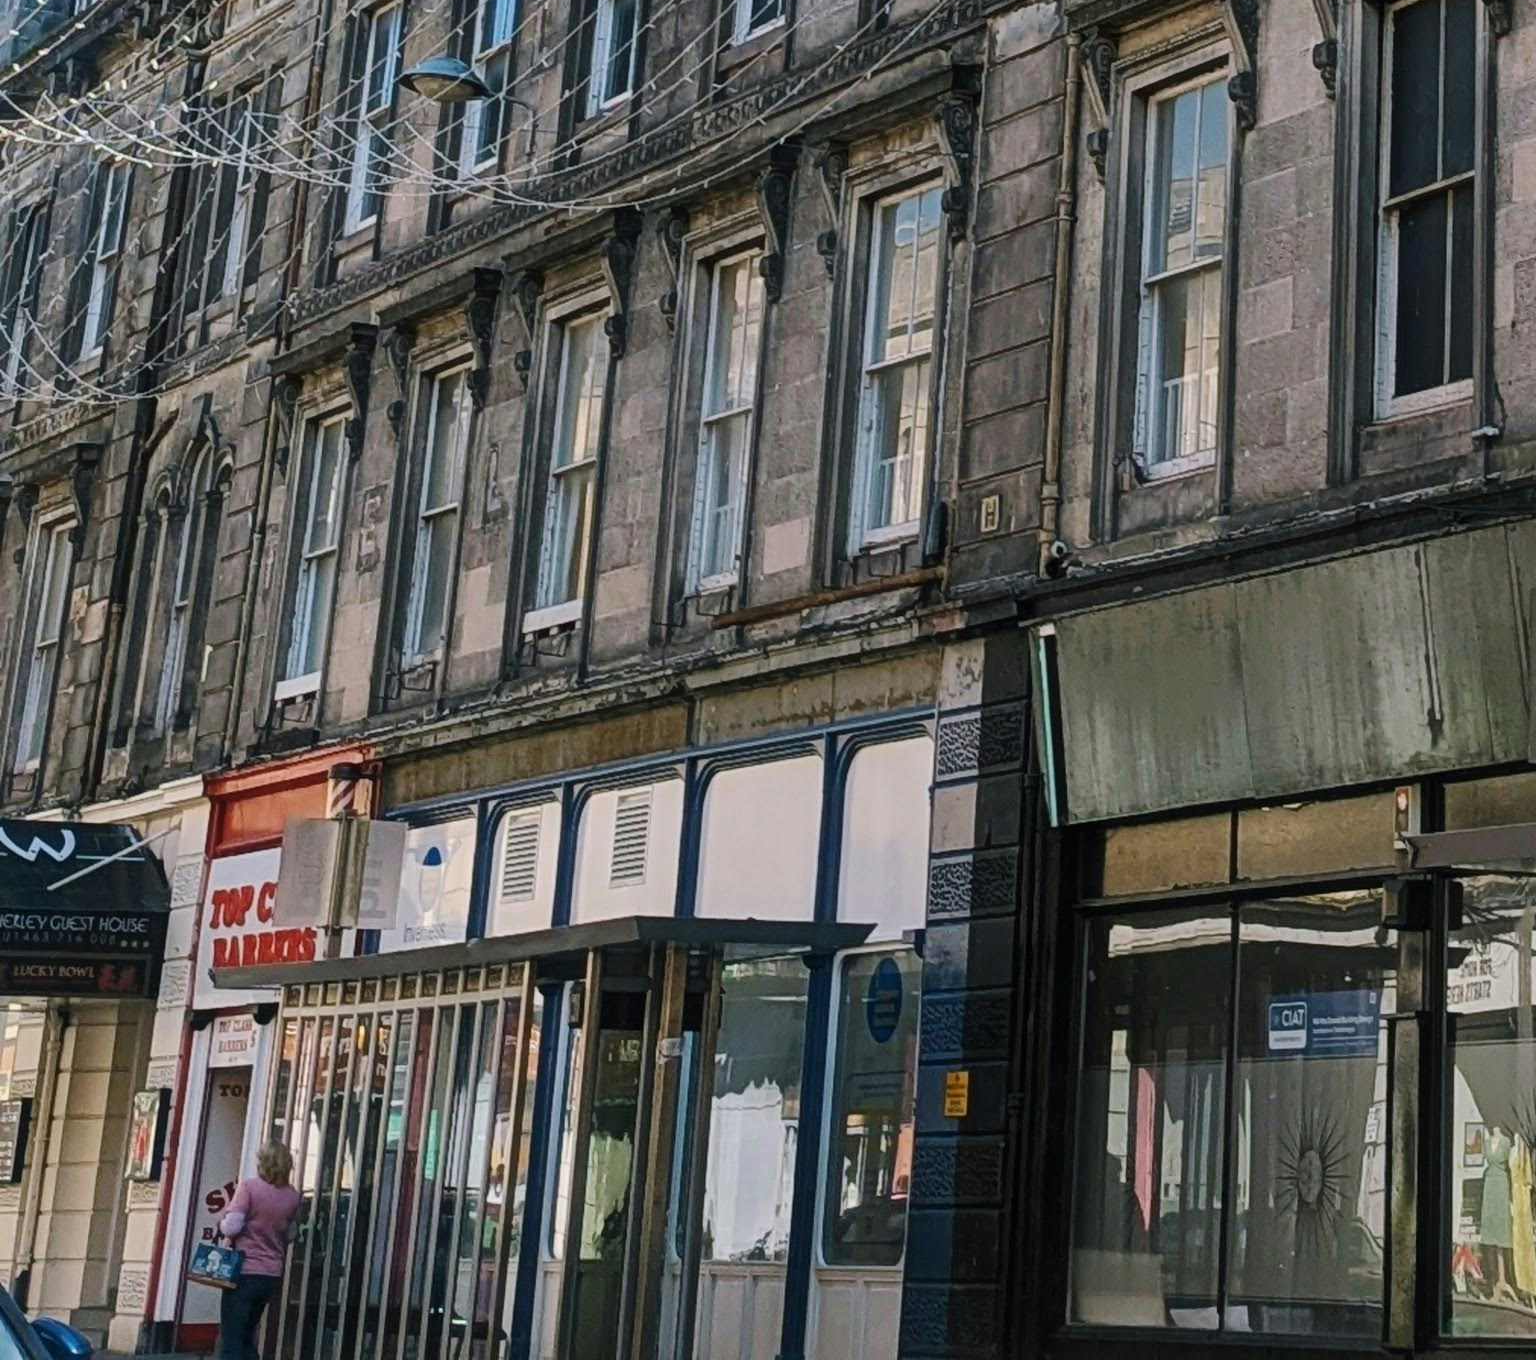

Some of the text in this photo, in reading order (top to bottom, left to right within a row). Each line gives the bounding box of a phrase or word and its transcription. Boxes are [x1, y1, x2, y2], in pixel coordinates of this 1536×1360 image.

[209, 884, 255, 930] TOP
[50, 915, 95, 931] GUEST
[99, 917, 150, 933] HOUSE
[212, 926, 318, 968] BARBERS
[14, 964, 95, 979] LUCKY BOWL
